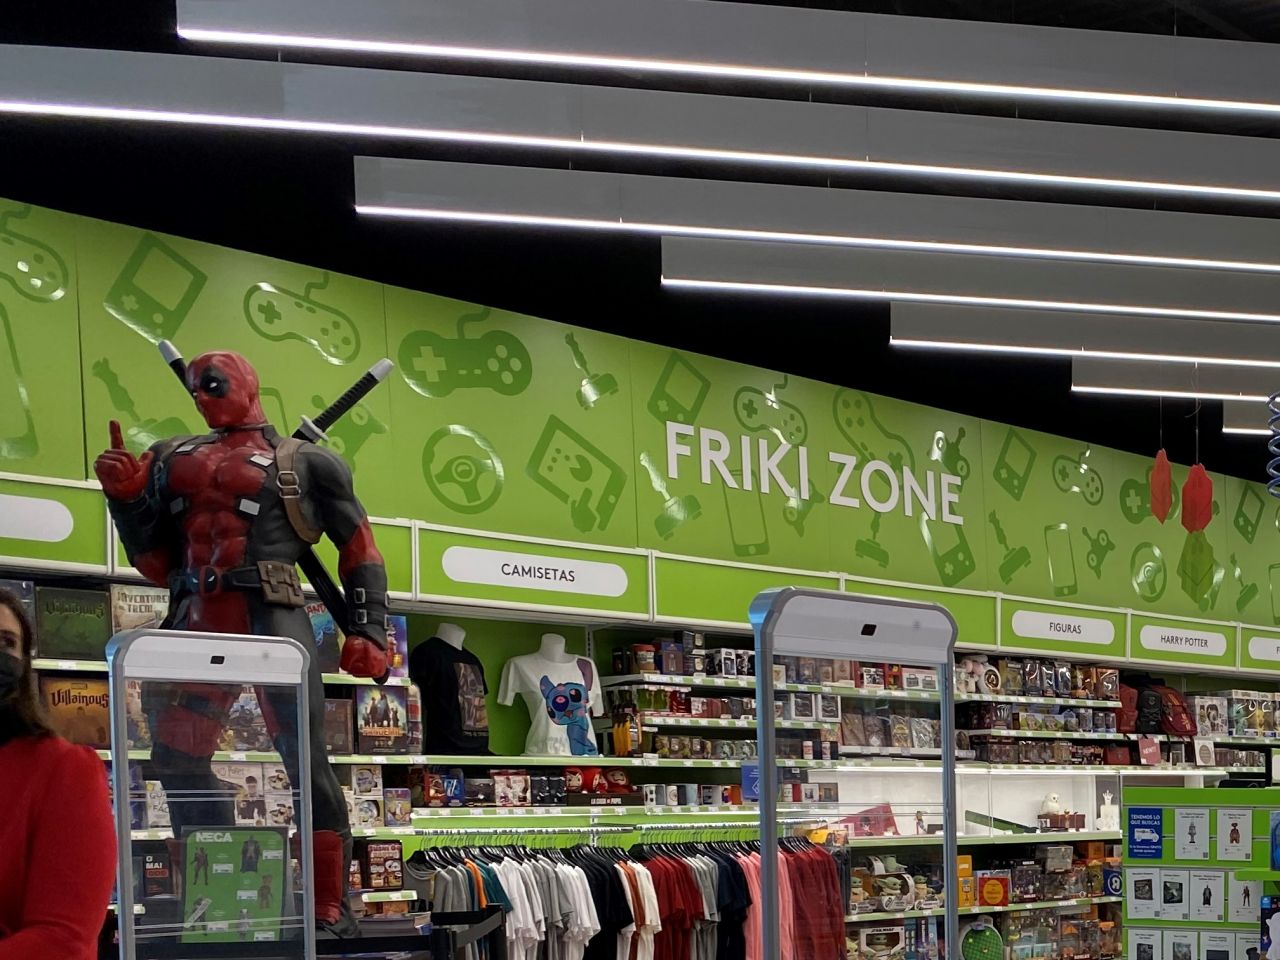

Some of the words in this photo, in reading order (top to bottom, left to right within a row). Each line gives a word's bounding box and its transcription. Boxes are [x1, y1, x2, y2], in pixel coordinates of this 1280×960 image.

[665, 420, 811, 501] FRIKI
[827, 451, 965, 526] ZONE
[500, 562, 576, 584] CAMISETAS
[1048, 621, 1083, 635] FIGURAS
[1160, 634, 1184, 647] HARRY
[1185, 636, 1209, 649] POTTER
[195, 831, 233, 843] NECA
